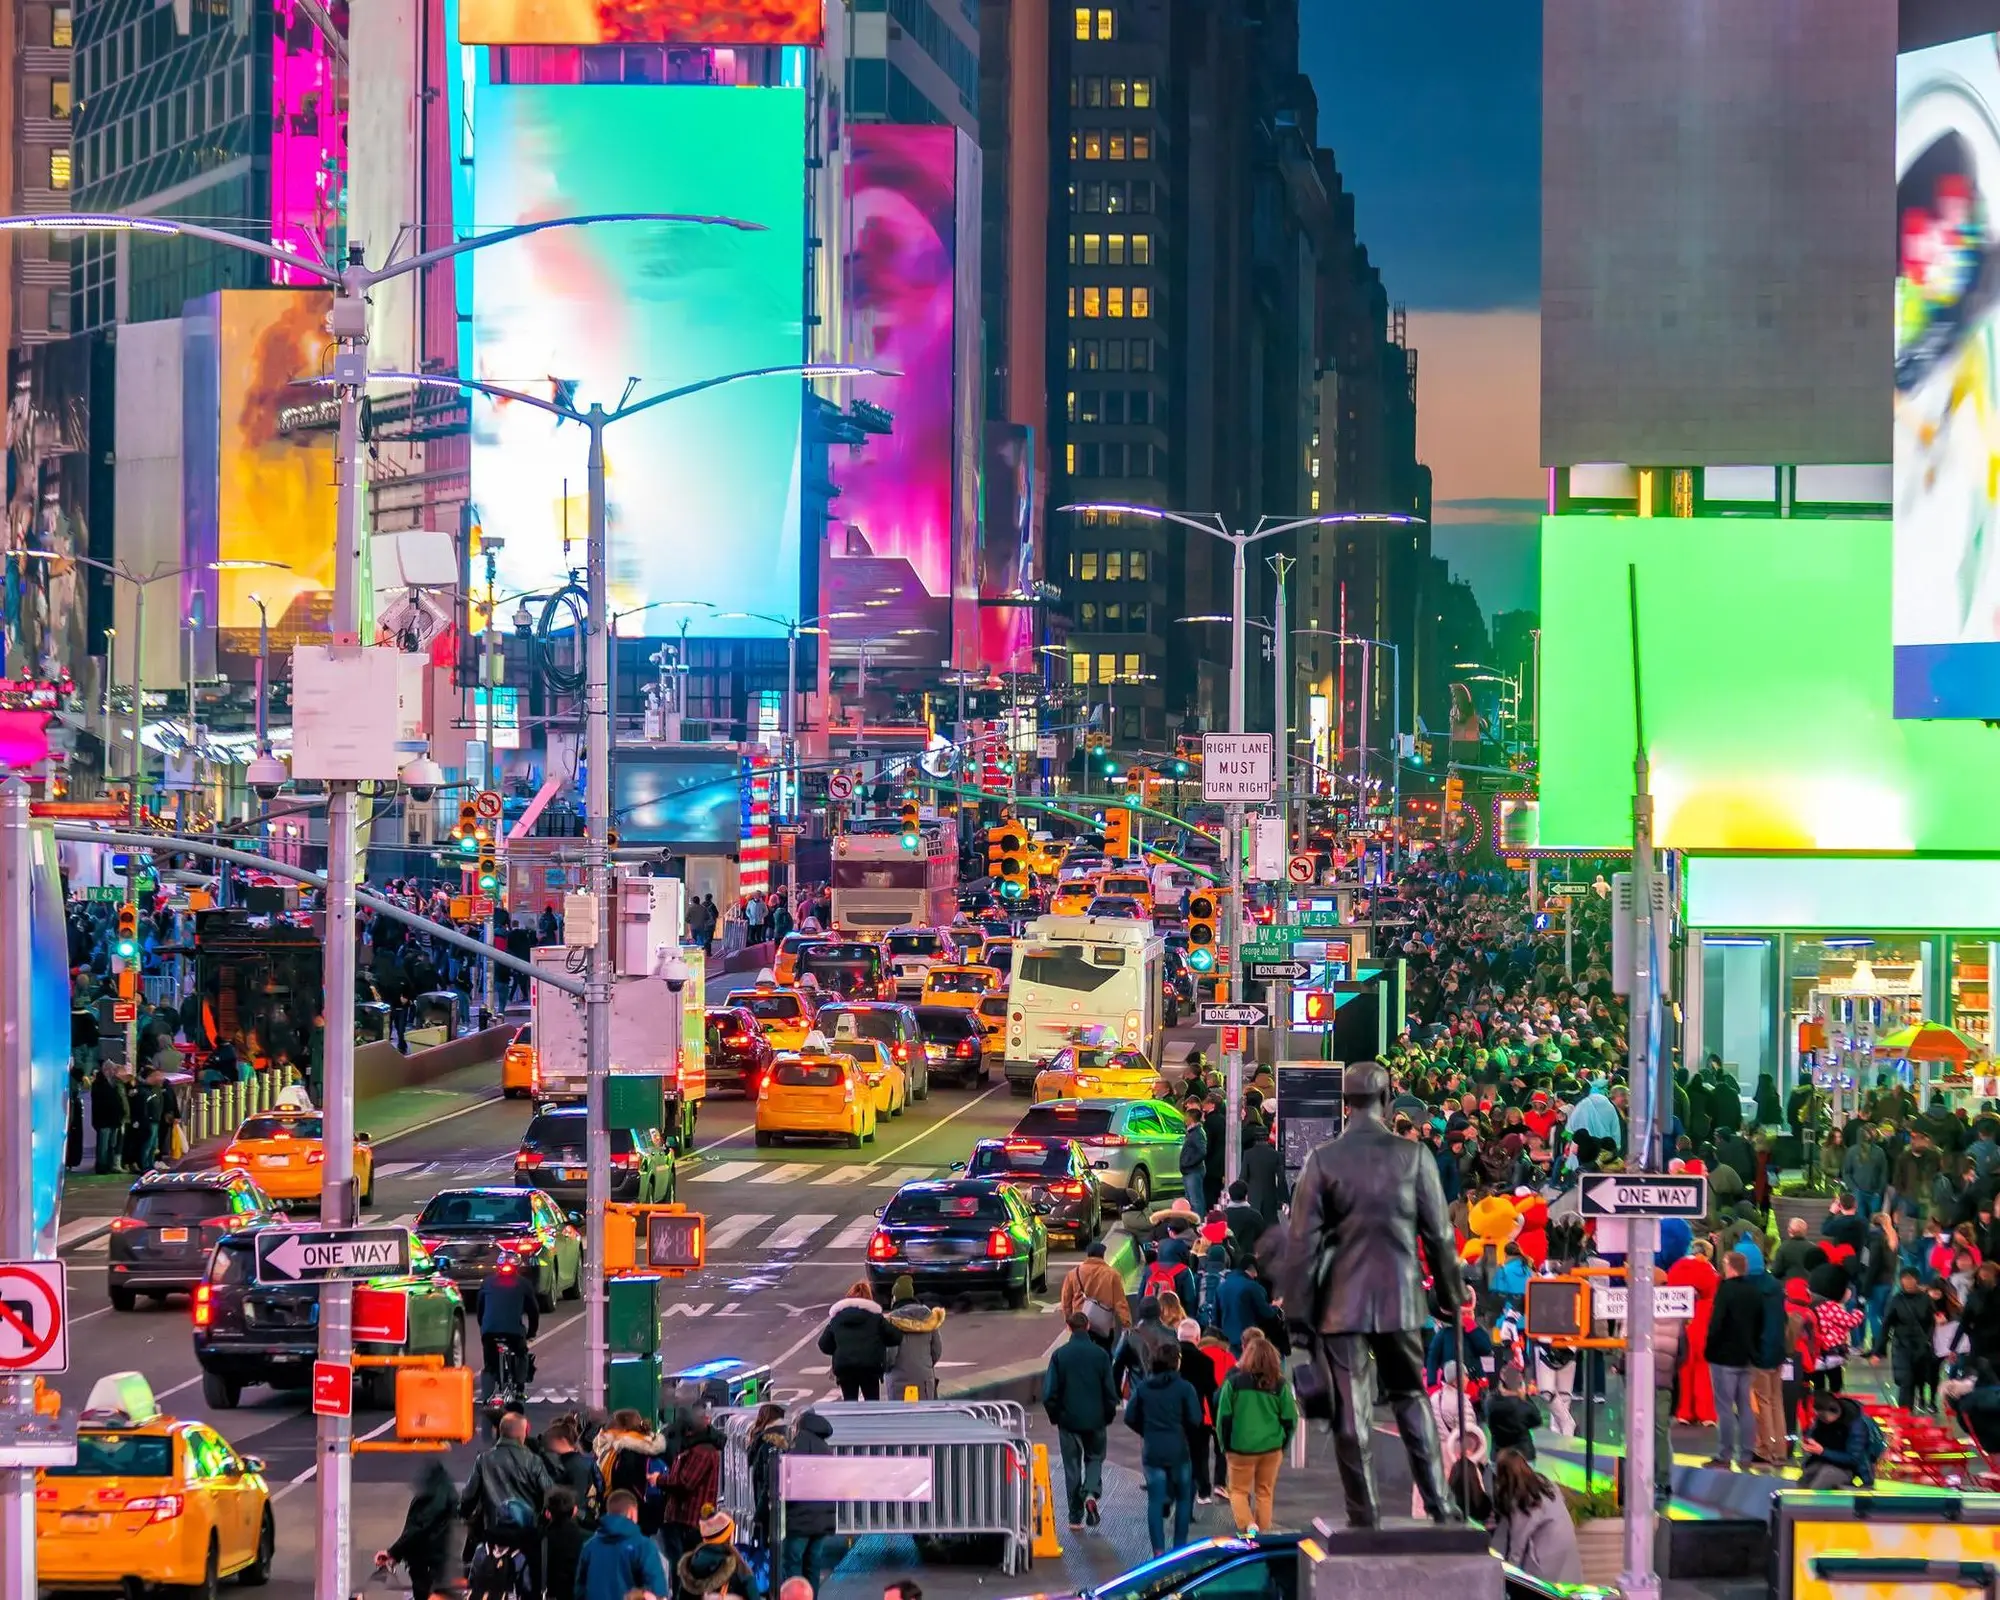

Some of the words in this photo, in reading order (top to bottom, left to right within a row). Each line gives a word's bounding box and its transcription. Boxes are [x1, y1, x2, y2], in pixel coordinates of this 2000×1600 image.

[1206, 743, 1237, 754] RIGHT
[1242, 743, 1269, 754] LANE
[1219, 761, 1256, 775] MUST
[1206, 782, 1233, 793] TURN
[1239, 782, 1269, 793] RIGHT
[88, 889, 98, 900] W
[102, 888, 114, 900] 45
[1302, 913, 1310, 923] W
[1315, 913, 1327, 923] 45
[1259, 928, 1270, 941] W
[1275, 928, 1288, 941] 45
[1241, 946, 1260, 957] George
[1262, 946, 1279, 956] Abbott
[1260, 966, 1276, 974] ONE
[1285, 966, 1302, 974] WAY
[1210, 1010, 1229, 1019] ONE
[1239, 1010, 1258, 1019] WAY
[1618, 1188, 1651, 1204] ONE
[1658, 1188, 1692, 1205] WAY
[304, 1246, 344, 1265] ONE
[352, 1243, 393, 1263] WAY
